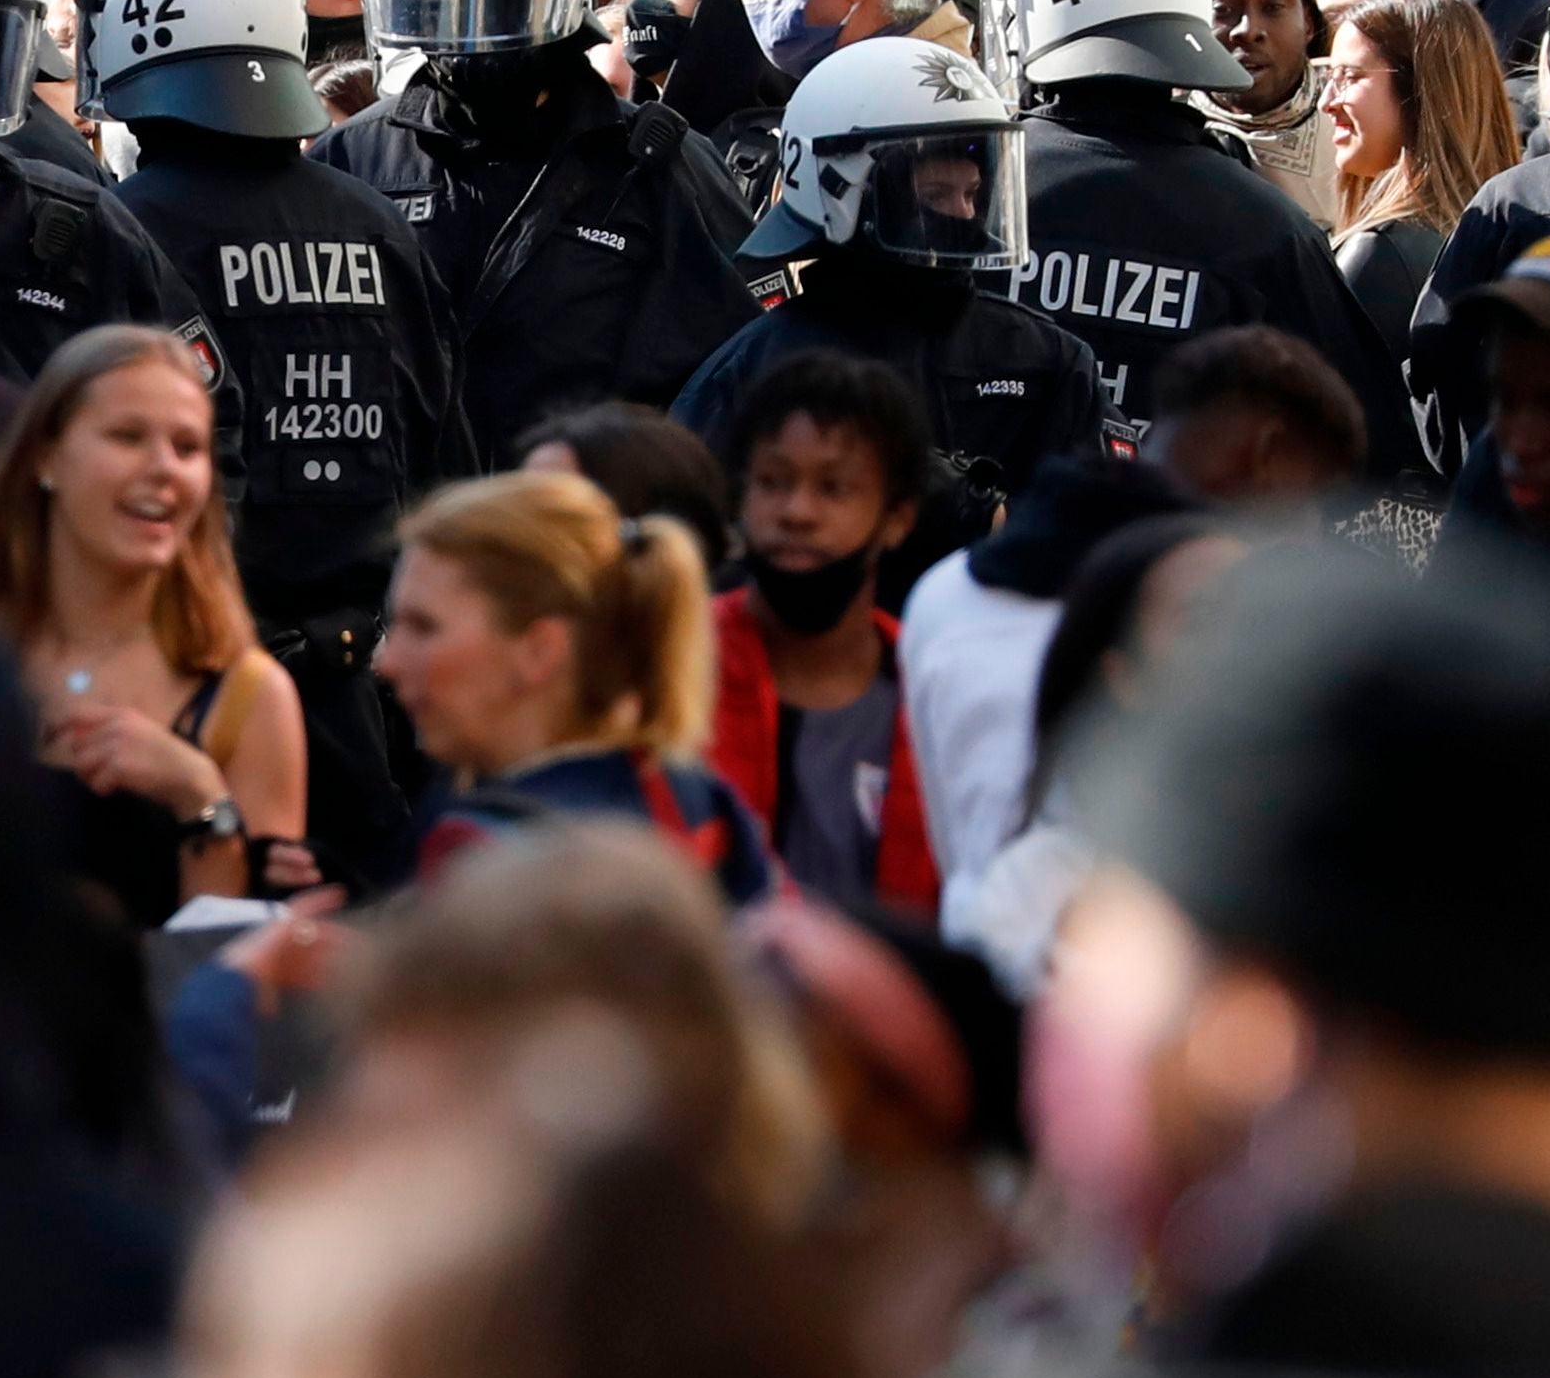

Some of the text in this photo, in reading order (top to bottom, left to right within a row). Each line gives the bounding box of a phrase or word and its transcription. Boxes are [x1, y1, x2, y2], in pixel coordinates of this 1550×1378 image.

[1184, 33, 1202, 53] 1
[247, 60, 267, 83] 3
[779, 130, 802, 190] 2
[575, 225, 626, 251] 142228
[220, 241, 385, 308] POLIZEI
[1007, 249, 1201, 330] POLIZEI
[15, 287, 67, 312] 142344
[285, 353, 352, 399] HH
[975, 380, 1025, 397] 142335
[264, 403, 384, 441] 142300
